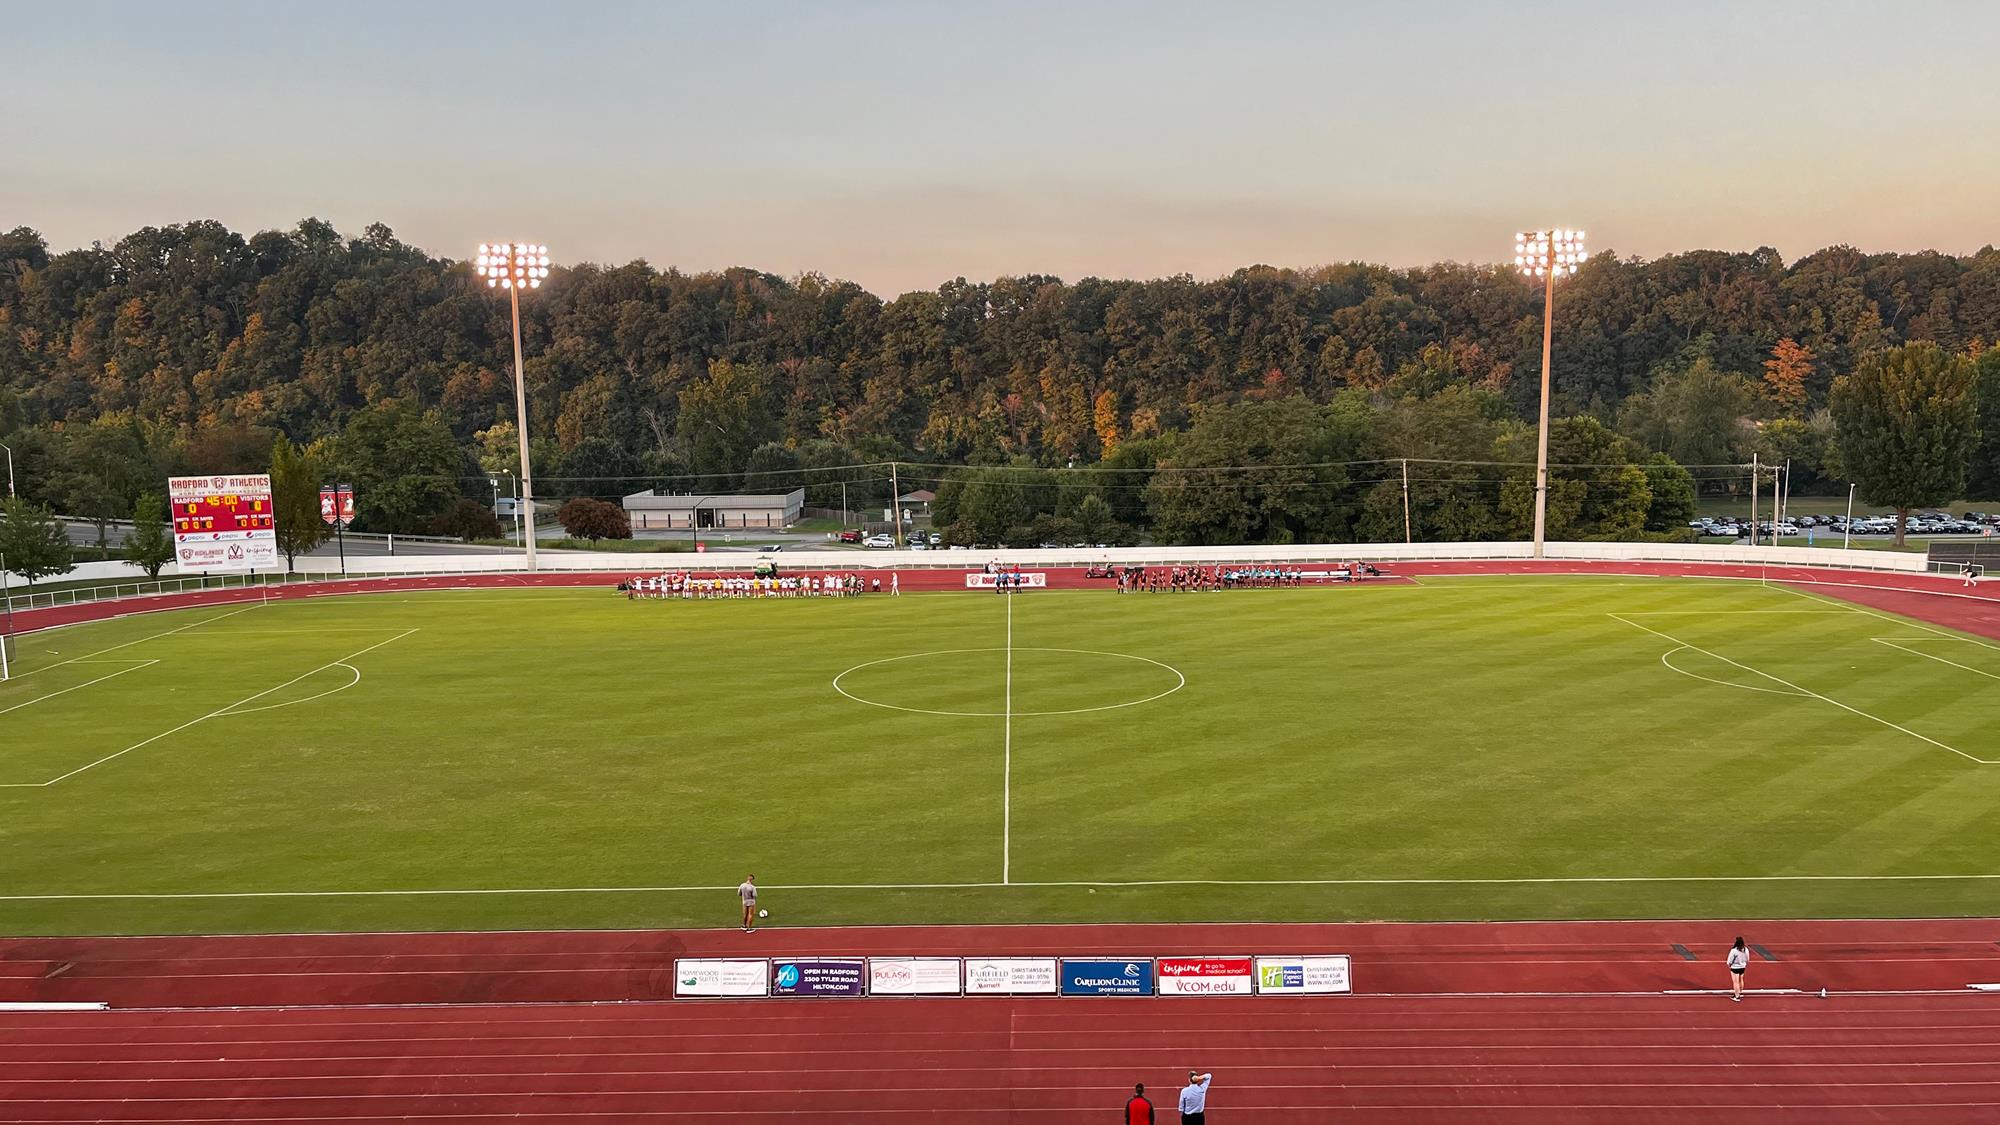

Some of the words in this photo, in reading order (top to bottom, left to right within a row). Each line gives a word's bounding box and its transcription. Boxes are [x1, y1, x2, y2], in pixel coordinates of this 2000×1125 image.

[171, 480, 208, 489] RADFORD
[230, 478, 269, 487] ATHLETICS
[207, 496, 238, 506] 45:00
[1164, 963, 1201, 975] inspired
[1176, 981, 1236, 992] VCOM.edu
